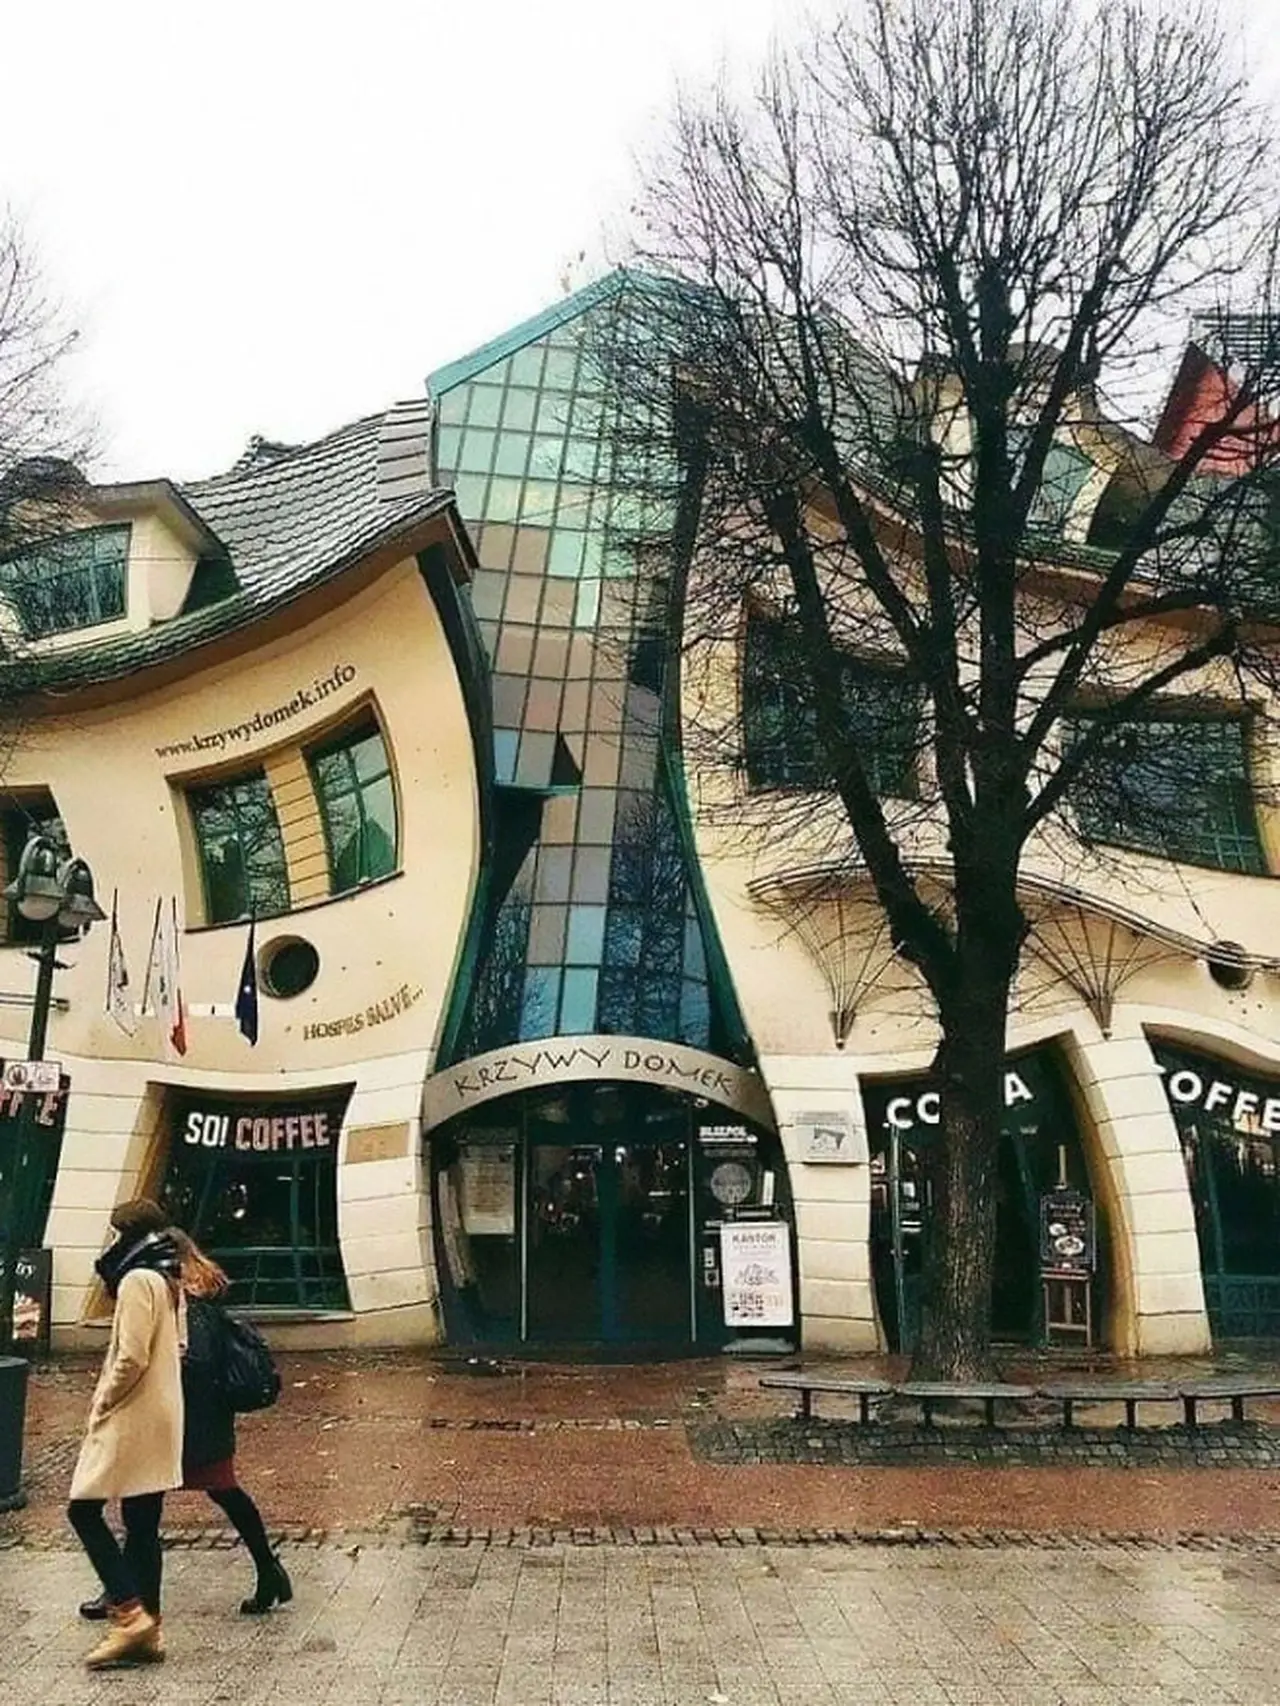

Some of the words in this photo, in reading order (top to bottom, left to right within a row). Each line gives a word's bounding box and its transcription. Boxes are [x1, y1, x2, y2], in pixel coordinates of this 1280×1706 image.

[154, 664, 356, 759] www.krzywydomek.info
[453, 1048, 611, 1098] KRZYWY
[624, 1050, 733, 1096] DOMEK
[886, 1072, 1034, 1129] COA
[184, 1112, 229, 1147] SO!
[234, 1113, 330, 1151] COFFEE
